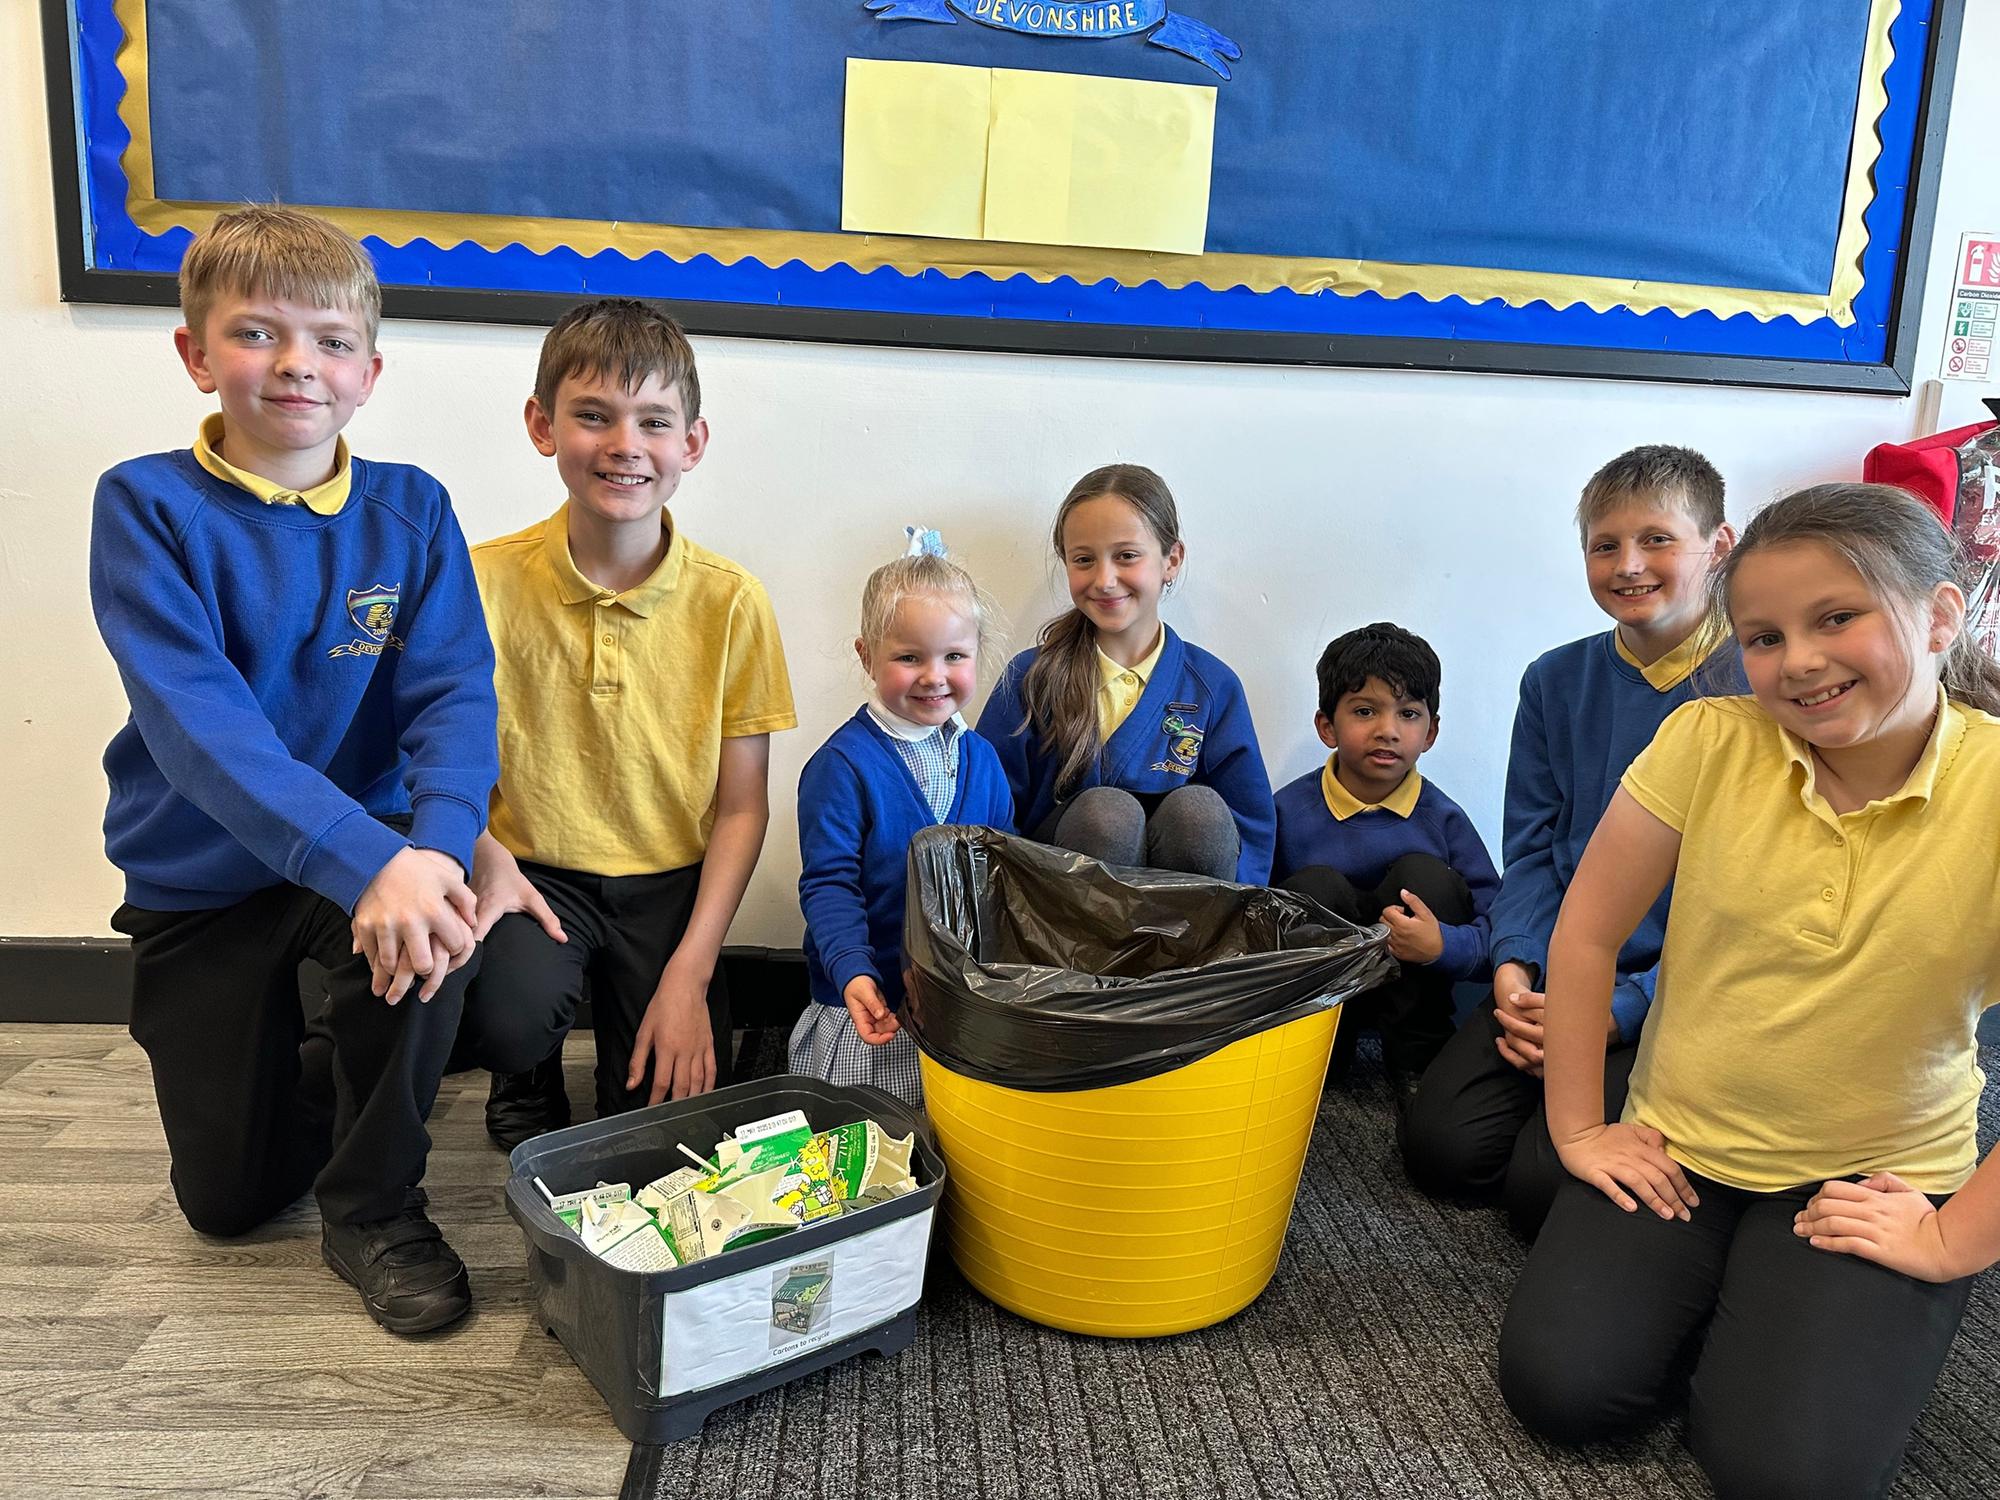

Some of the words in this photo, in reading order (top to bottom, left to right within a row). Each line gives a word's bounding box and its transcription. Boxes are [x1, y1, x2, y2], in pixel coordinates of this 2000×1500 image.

[975, 0, 1138, 32] DEVONSHIRE
[1960, 290, 1980, 298] Carbon
[836, 1128, 849, 1181] MILK
[772, 1343, 799, 1356] Cartons
[799, 1339, 807, 1348] to
[808, 1330, 830, 1344] recycle
